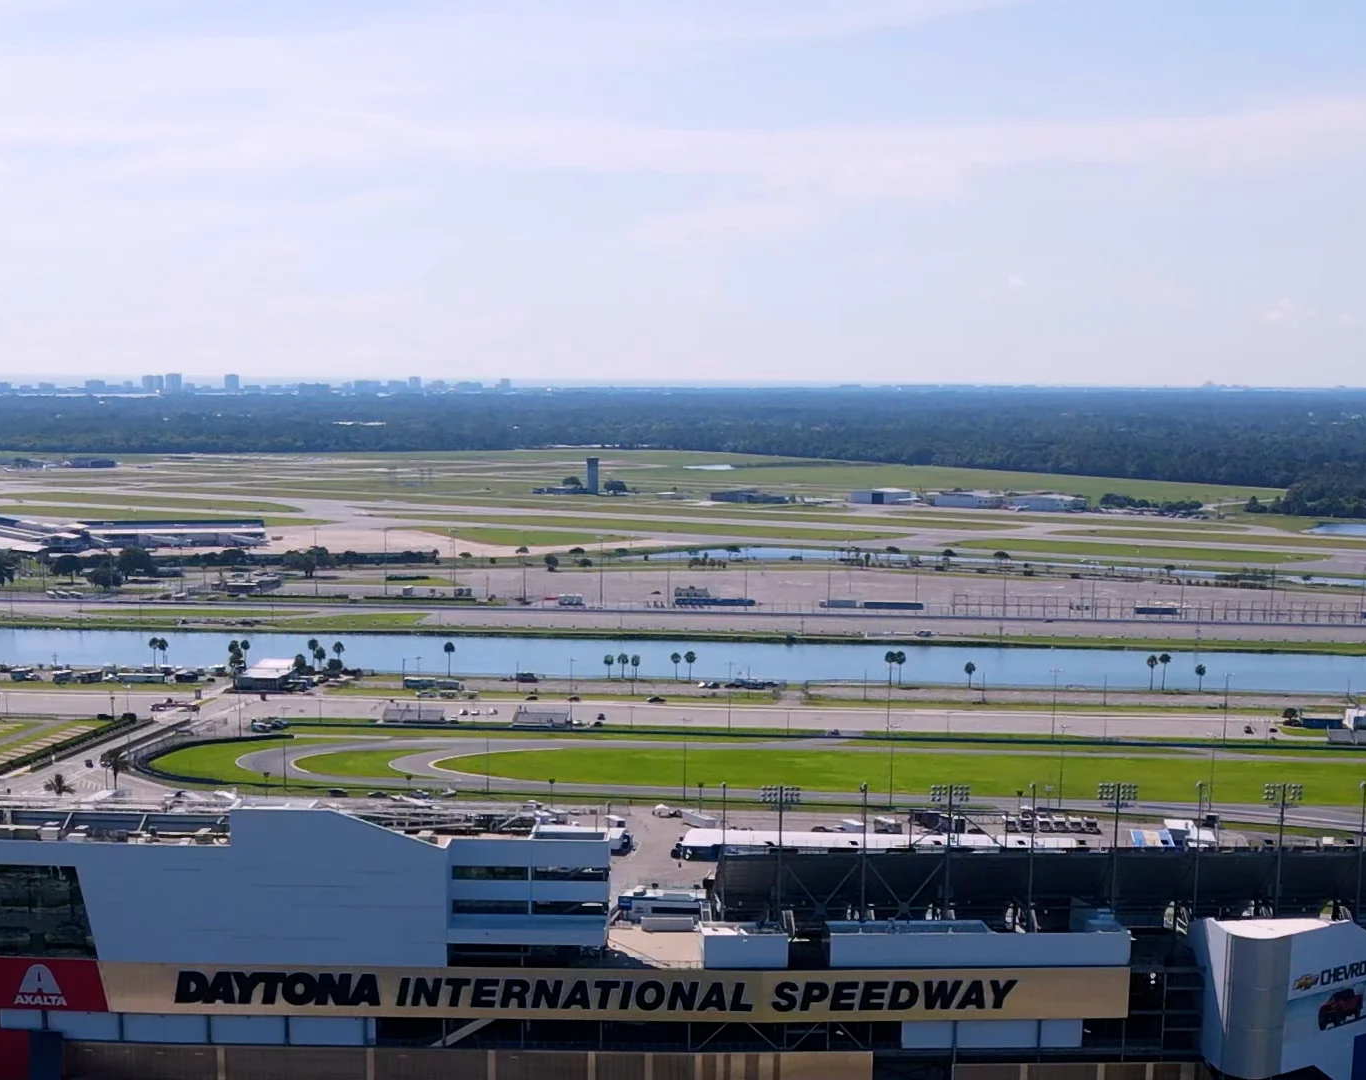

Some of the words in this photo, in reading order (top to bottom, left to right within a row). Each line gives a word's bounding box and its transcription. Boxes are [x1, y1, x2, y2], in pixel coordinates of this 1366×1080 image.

[13, 994, 68, 1006] AXALTA
[174, 970, 381, 1007] DAYTONA
[396, 977, 753, 1012] INTERNATIONAL
[771, 979, 1018, 1012] SPEEDWAY
